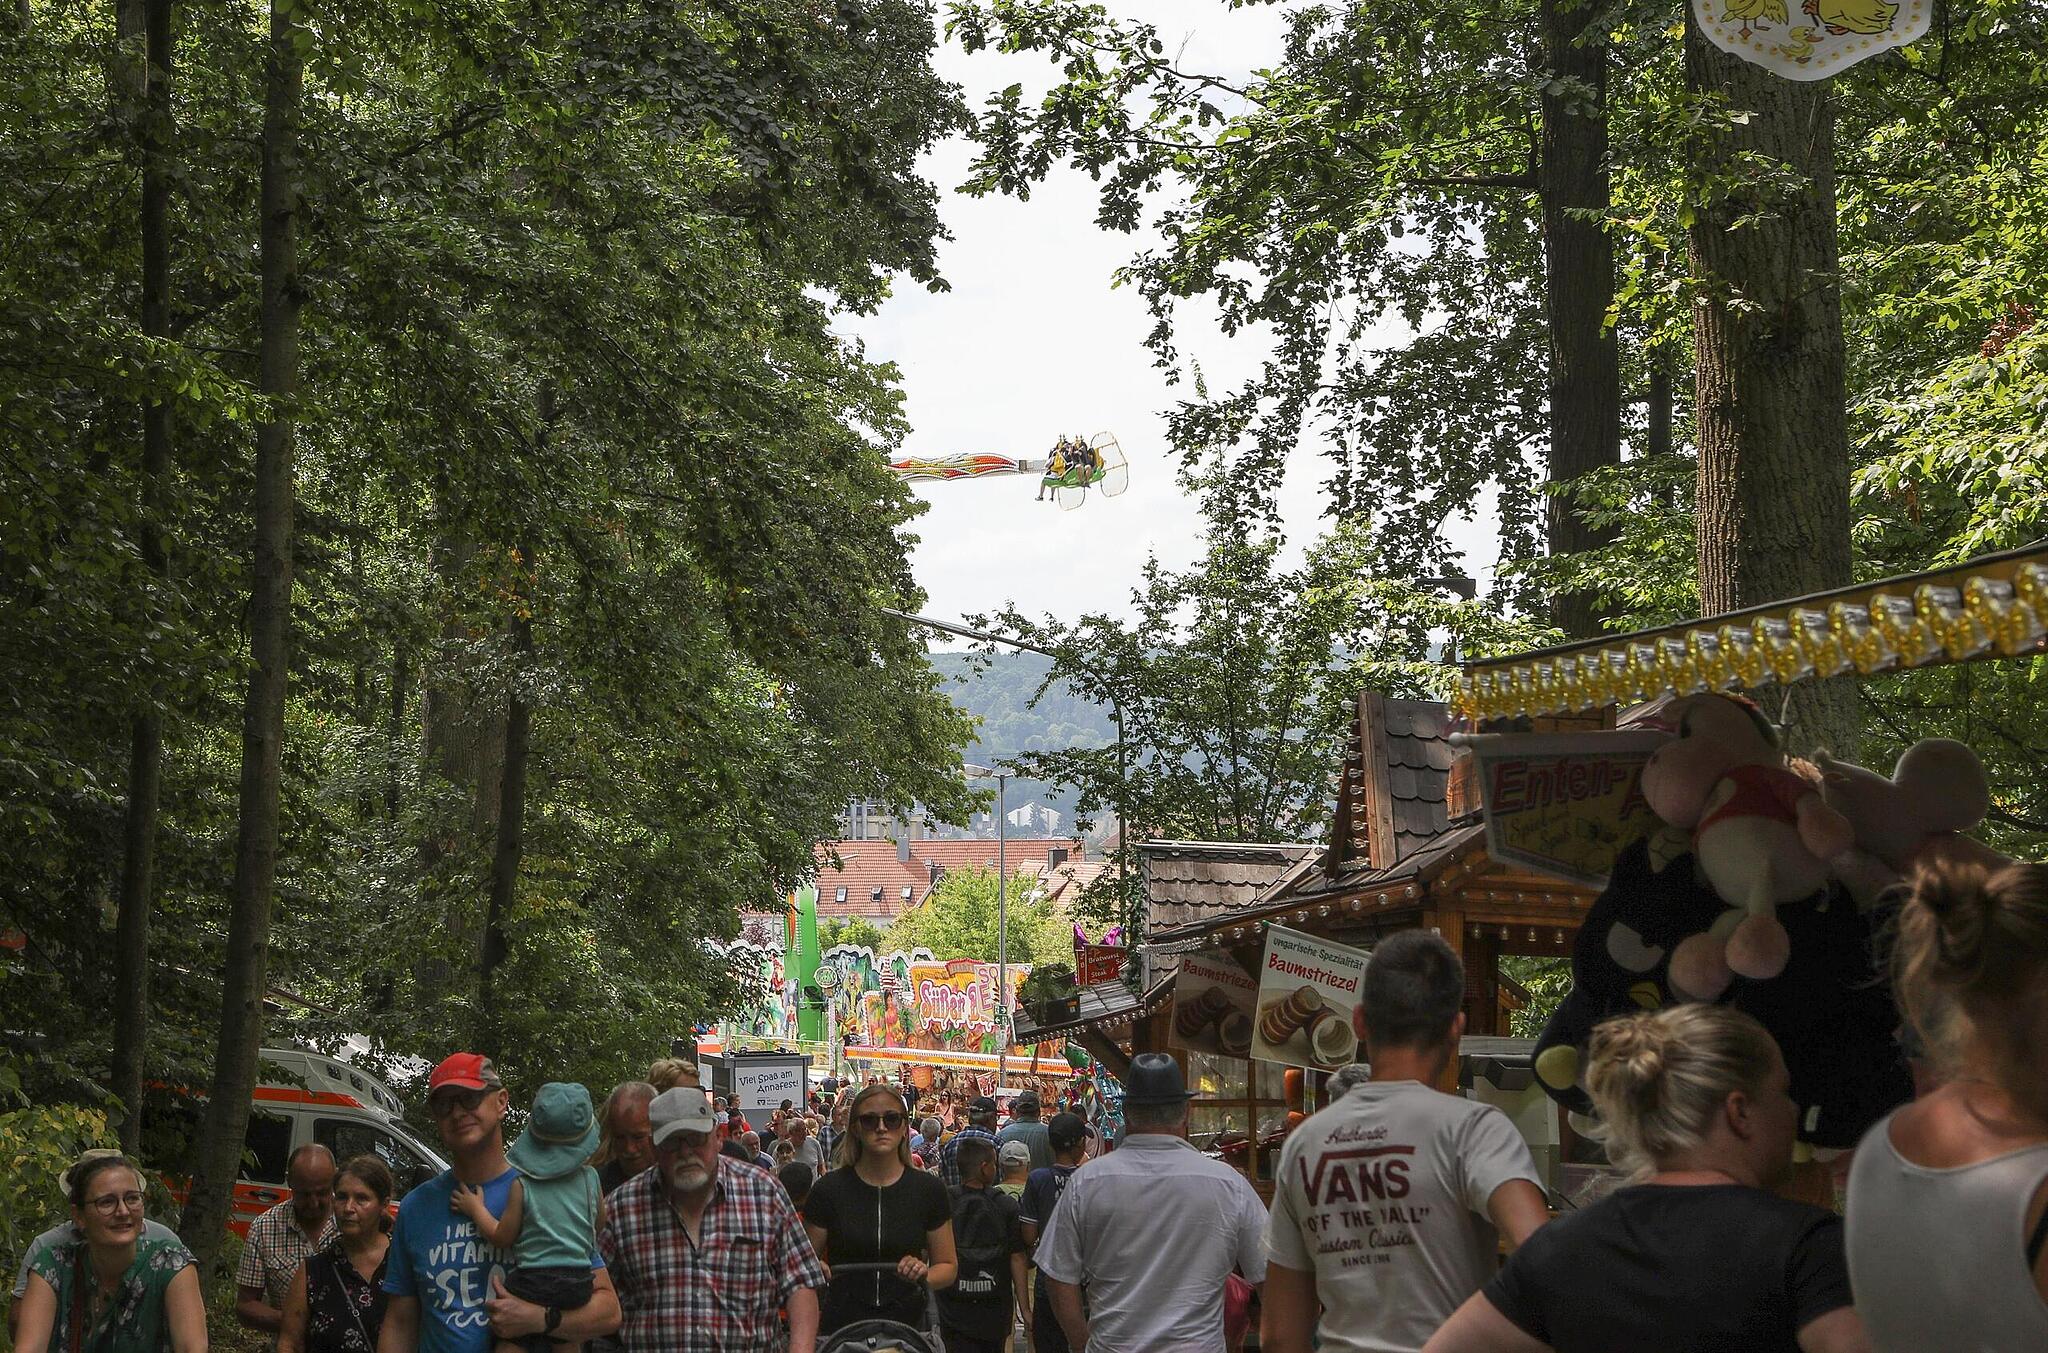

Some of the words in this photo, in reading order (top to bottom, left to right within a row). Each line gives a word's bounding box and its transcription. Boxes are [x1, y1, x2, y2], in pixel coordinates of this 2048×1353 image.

[1318, 950, 1364, 971] Spezialität
[1268, 952, 1360, 993] Baumstriezel
[739, 1075, 756, 1087] Viel
[757, 1072, 779, 1084] Spaß
[780, 1070, 793, 1079] am
[756, 1079, 799, 1094] Annafest!
[1299, 1145, 1416, 1207] VANS
[1340, 1210, 1375, 1229] THE
[446, 1225, 451, 1241] I
[1341, 1254, 1372, 1267] SINCE
